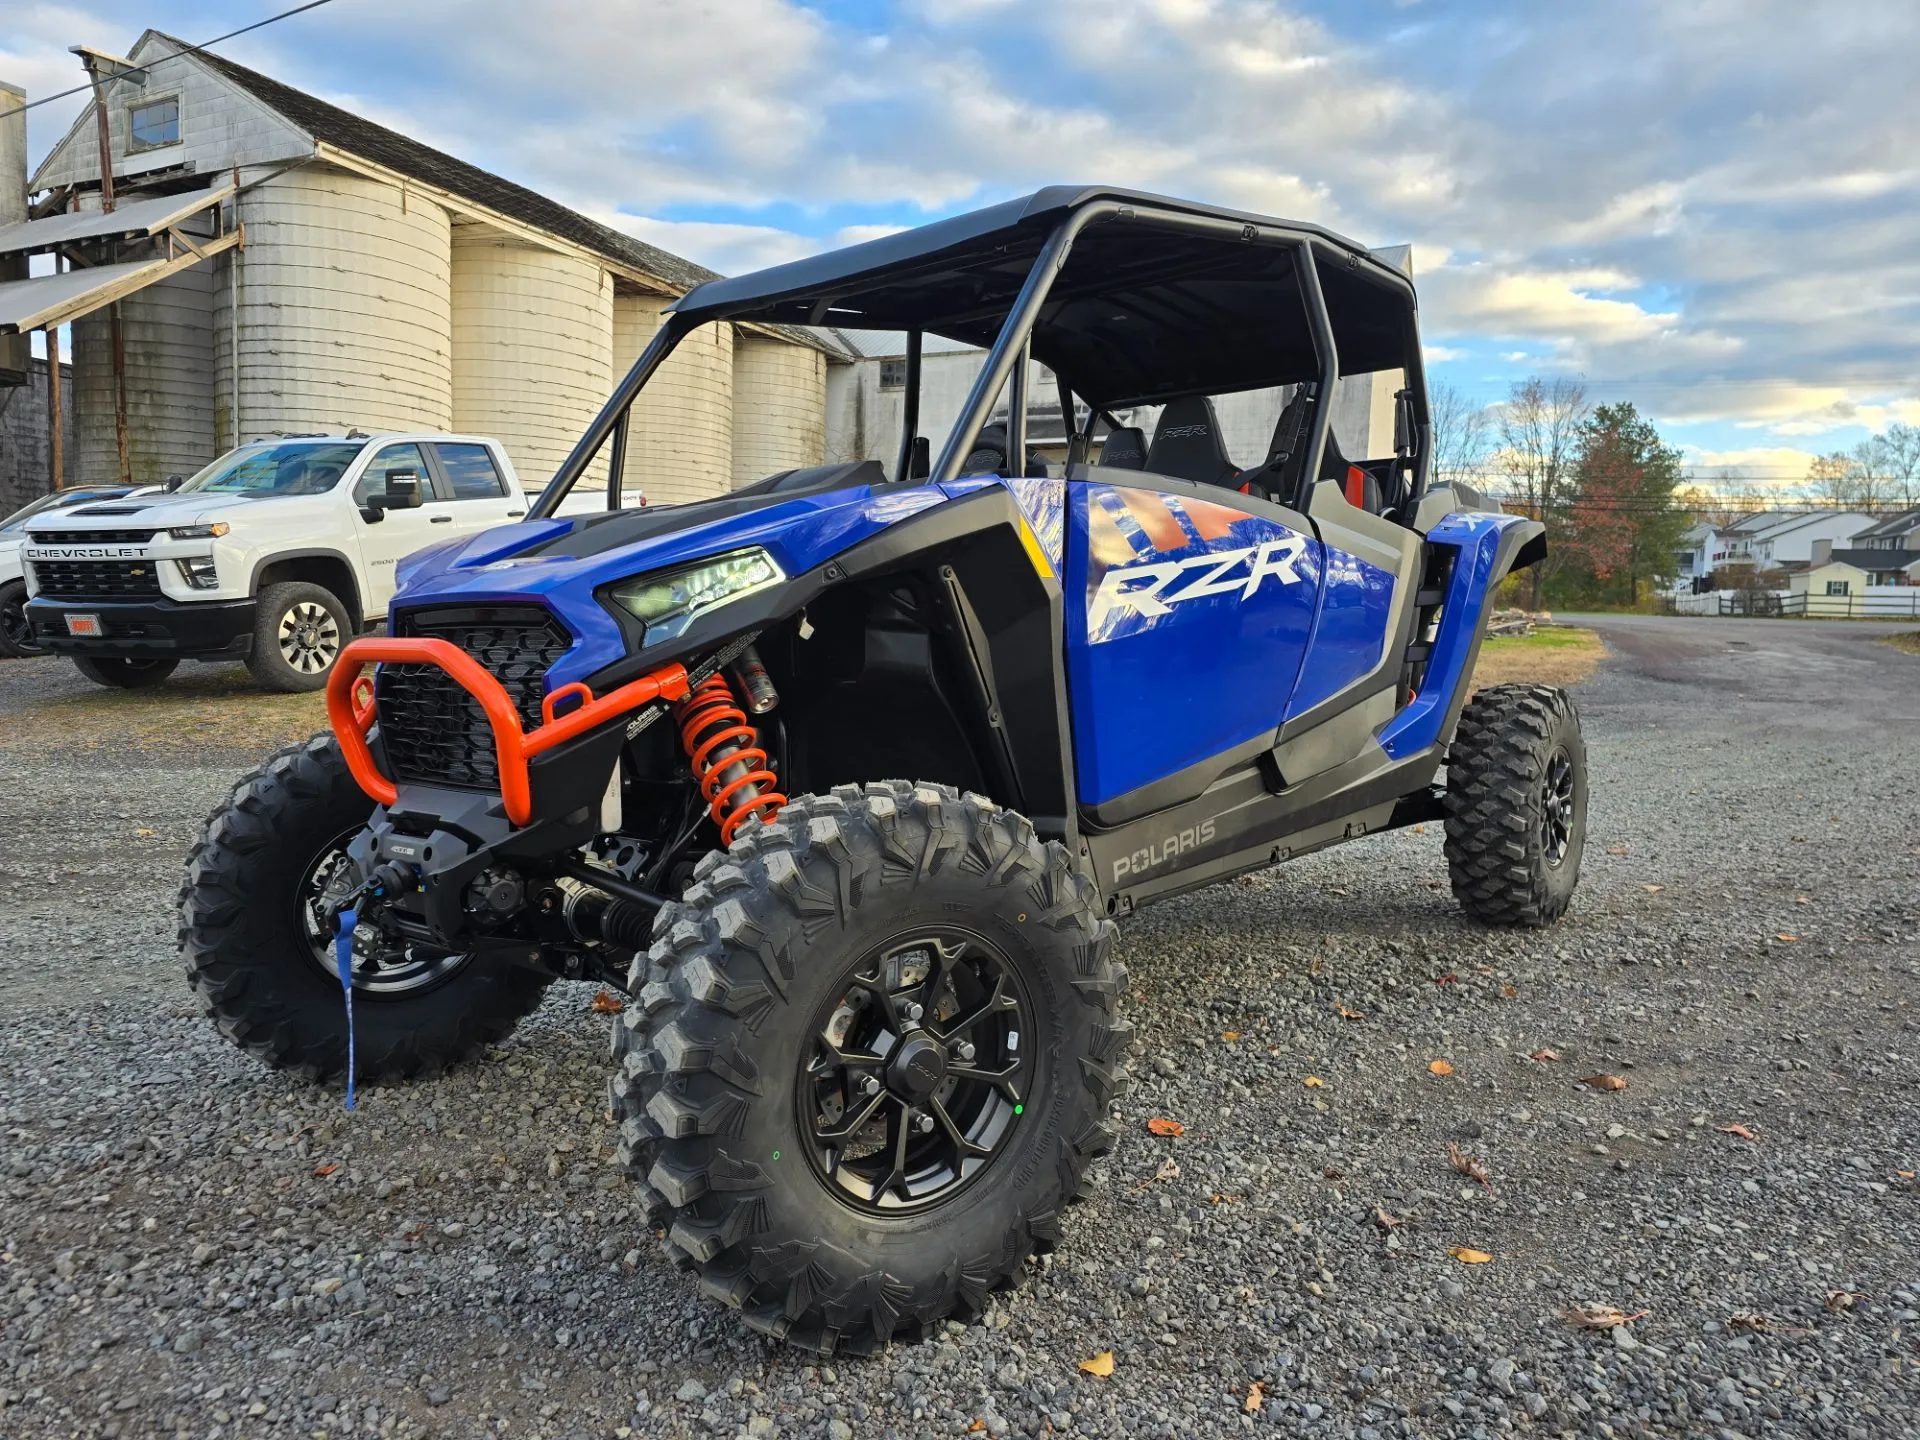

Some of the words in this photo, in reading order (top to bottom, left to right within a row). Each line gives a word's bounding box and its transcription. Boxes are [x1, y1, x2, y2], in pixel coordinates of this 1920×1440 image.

[26, 548, 149, 558] CHEVROLET
[1087, 535, 1307, 635] RZR
[1112, 819, 1217, 884] POLARIS
